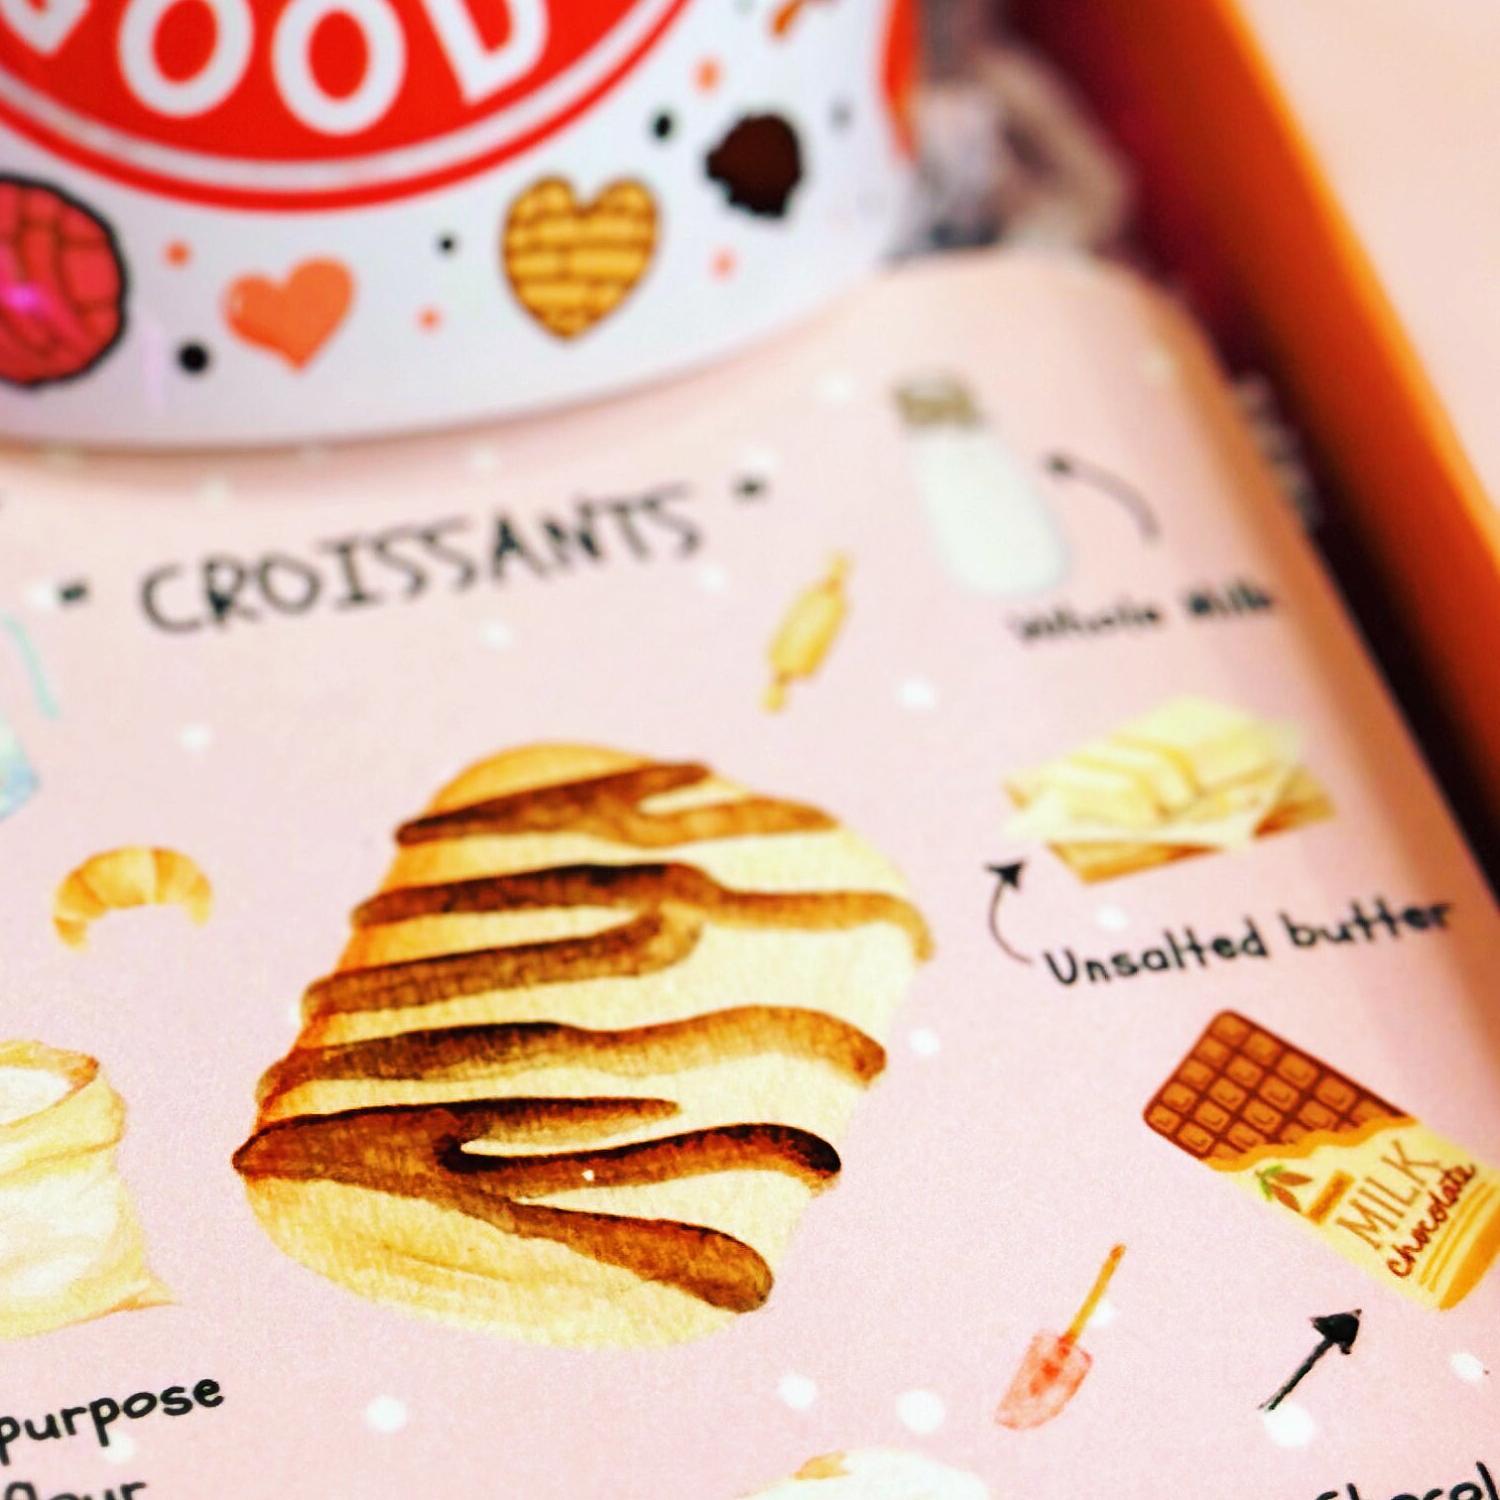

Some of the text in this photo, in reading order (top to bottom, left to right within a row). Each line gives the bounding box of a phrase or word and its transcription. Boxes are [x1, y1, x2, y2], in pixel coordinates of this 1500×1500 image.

[139, 481, 704, 634] CROISSANTS
[1183, 578, 1274, 617] Milk
[1043, 896, 1453, 987] Unsalted butter
[1336, 1139, 1440, 1251] MILK
